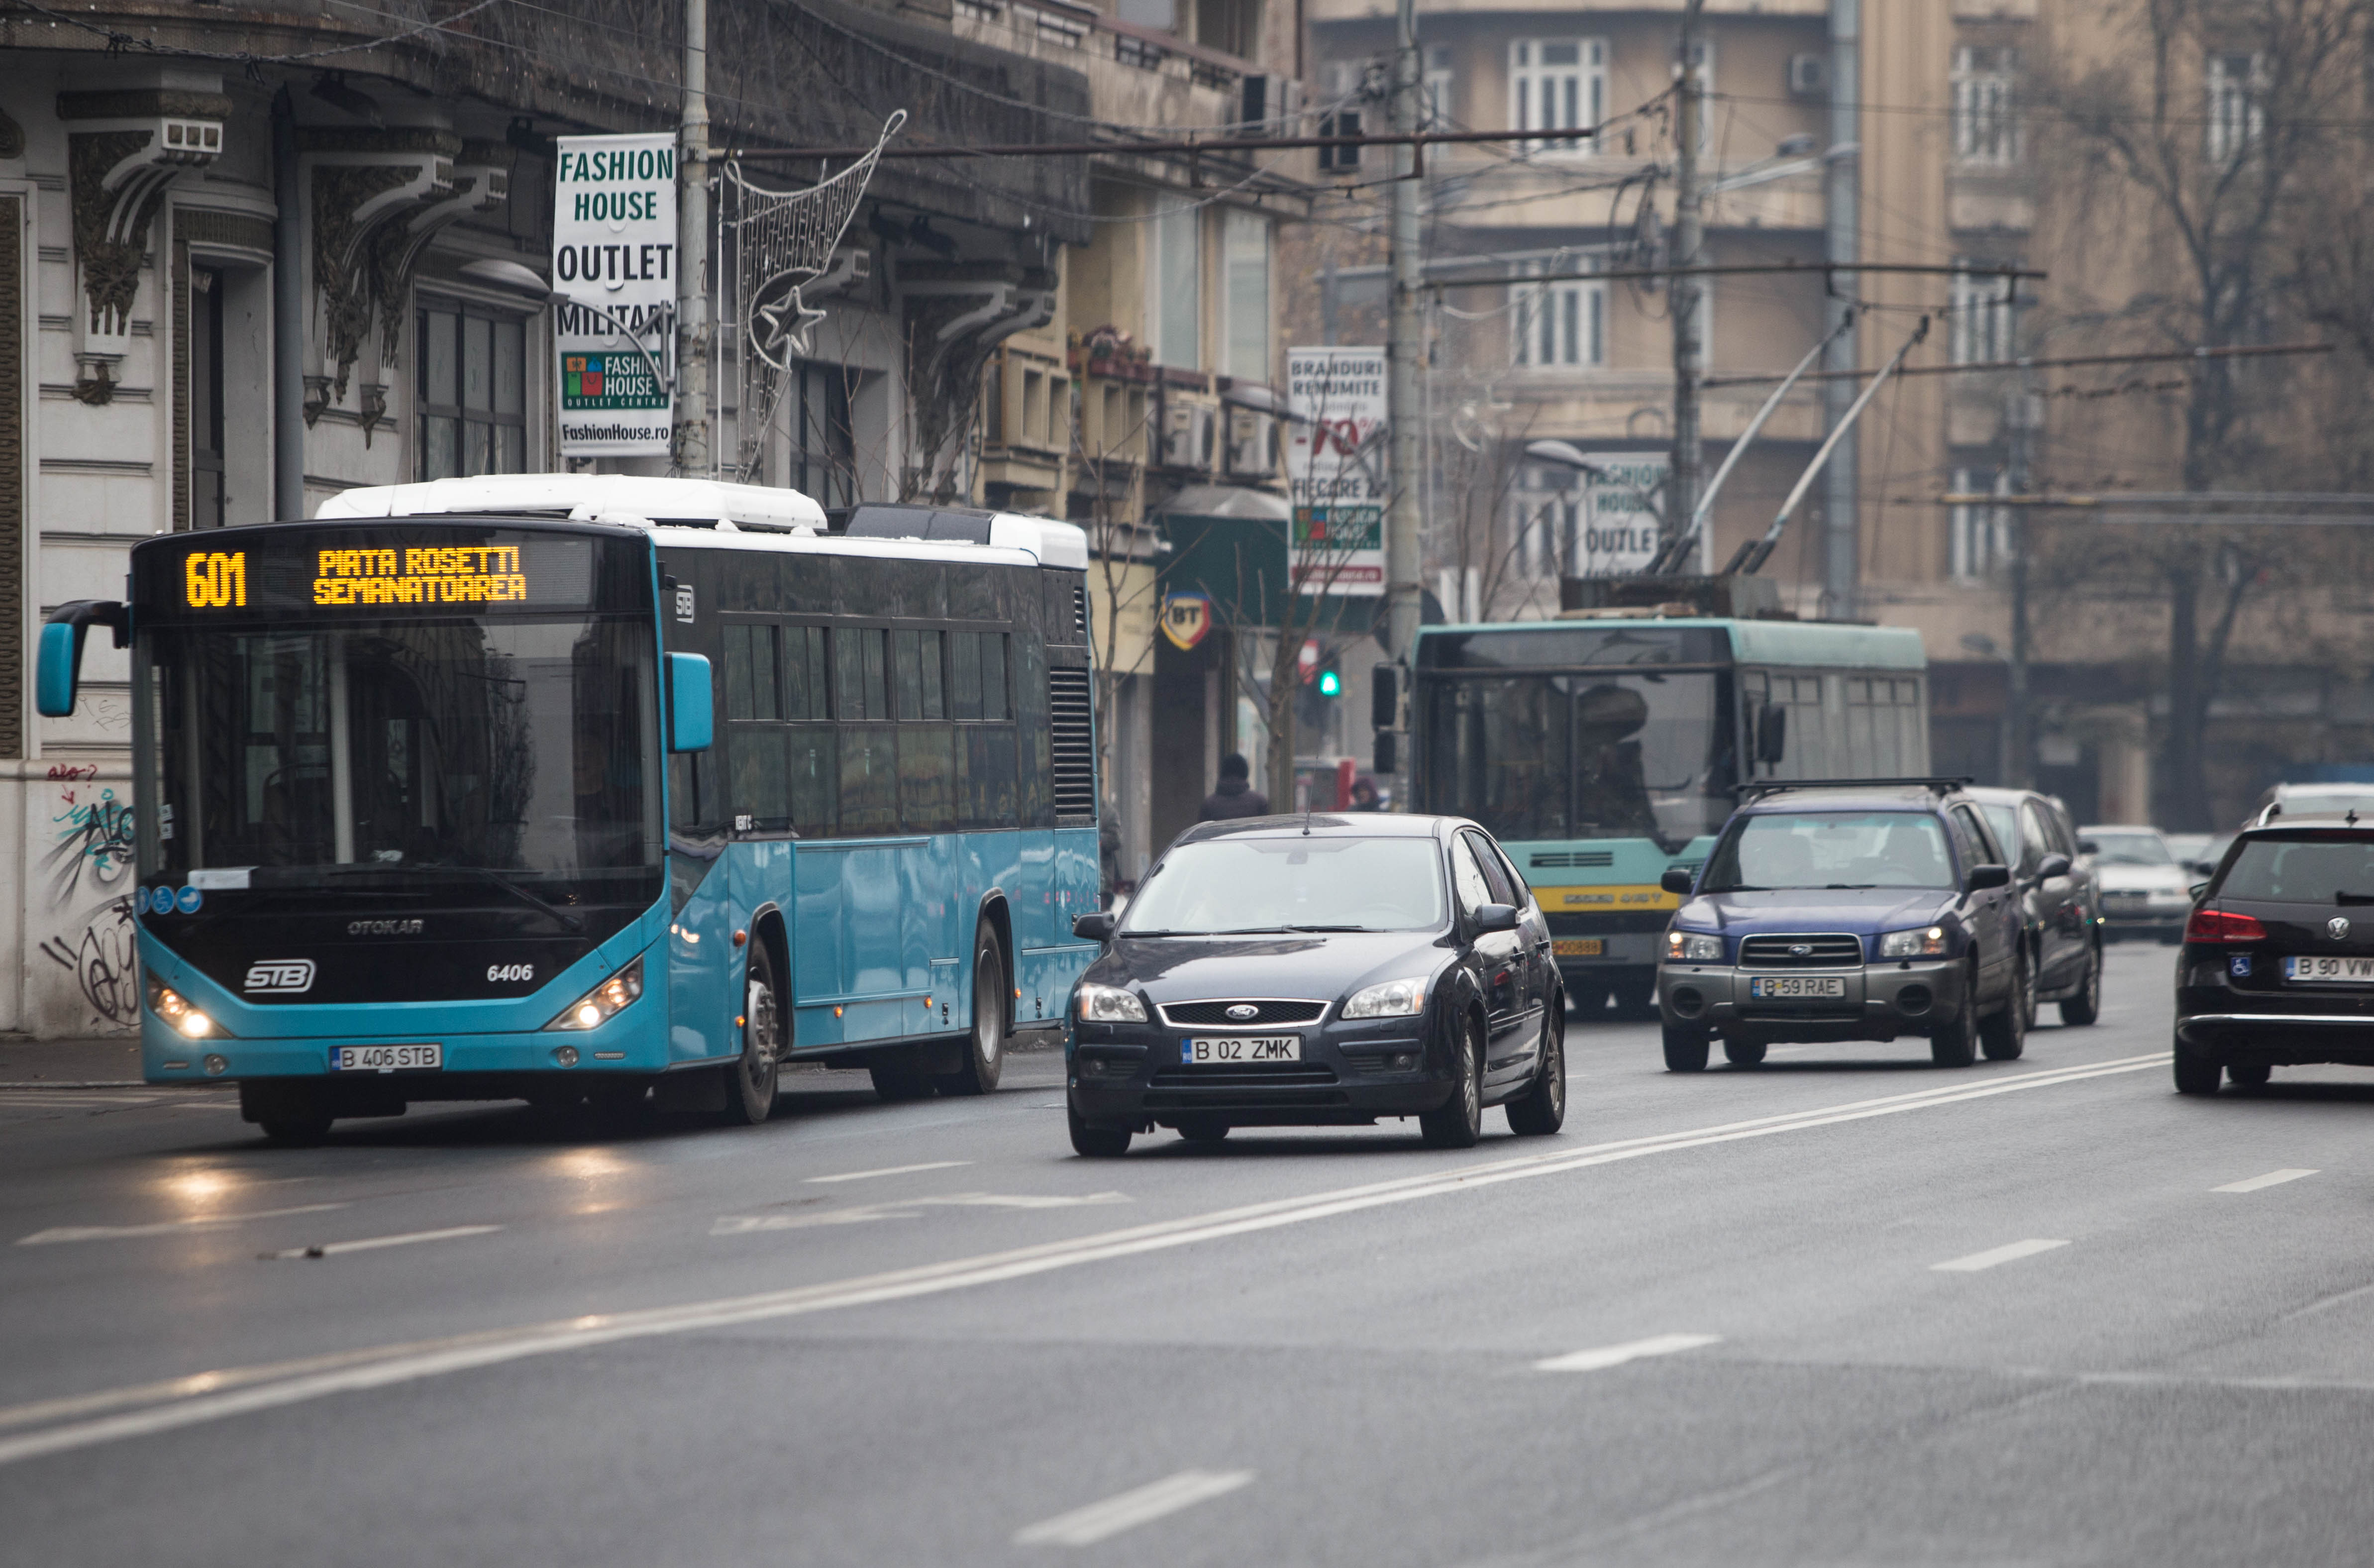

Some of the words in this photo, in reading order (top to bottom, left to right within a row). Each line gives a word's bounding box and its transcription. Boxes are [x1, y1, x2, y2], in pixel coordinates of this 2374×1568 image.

[560, 149, 673, 182] FASHION
[574, 192, 657, 220] HOUSE
[557, 244, 672, 282] OUTLET
[1292, 361, 1382, 376] BRANDURI
[605, 377, 652, 396] HOUSE
[563, 423, 668, 441] FashionHouse.ro
[319, 549, 397, 576] PIATA
[405, 546, 519, 574] ROSETTI
[186, 552, 246, 607] 601
[313, 574, 527, 604] SEMANATOAREA
[1172, 606, 1200, 624] BT
[347, 920, 423, 936] OTOKAR
[244, 966, 308, 987] STB
[487, 964, 533, 982] 6406
[2299, 958, 2312, 975] B
[2318, 959, 2339, 975] 90
[2347, 959, 2374, 976] VW
[1764, 979, 1775, 994] B
[1782, 980, 1800, 994] 59
[1805, 979, 1837, 994] RAE
[342, 1050, 354, 1067] B
[362, 1048, 394, 1066] 406
[398, 1047, 435, 1065] STB
[1196, 1041, 1210, 1060] B
[1218, 1041, 1241, 1059] 02
[1251, 1039, 1292, 1059] ZMK
